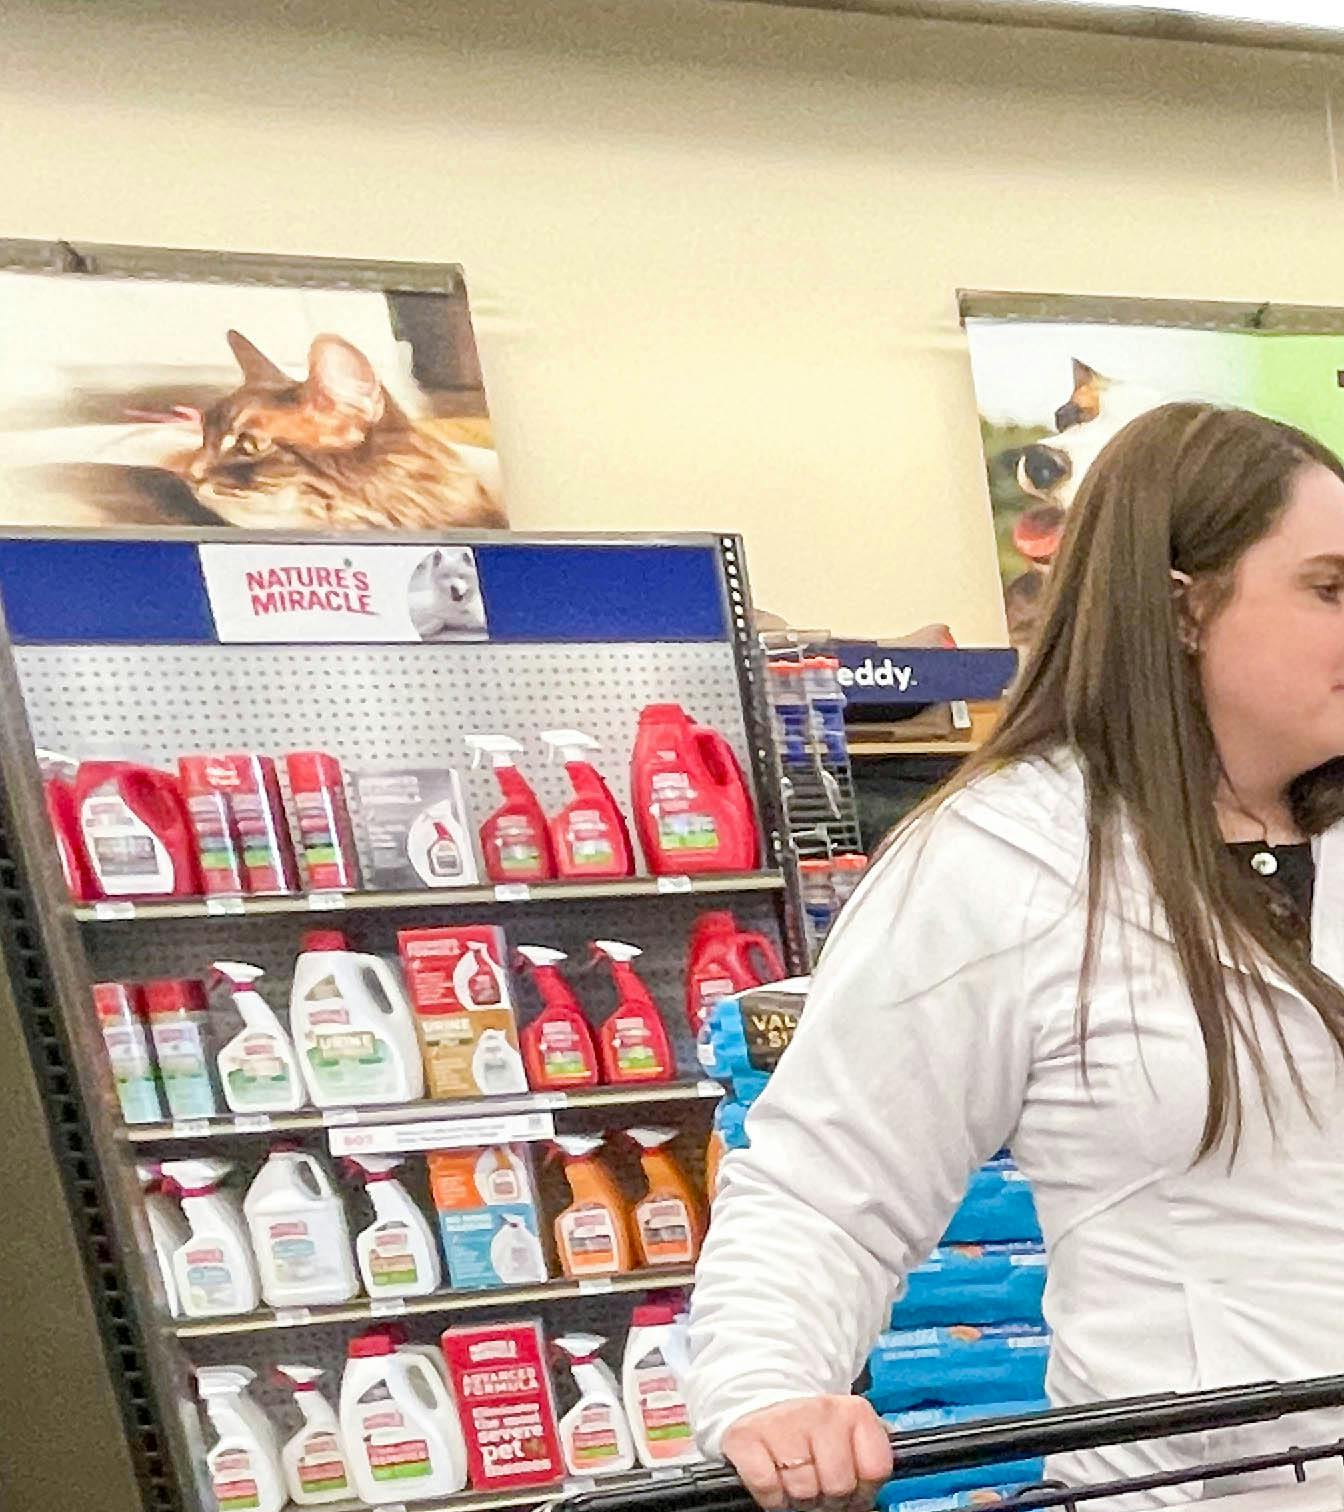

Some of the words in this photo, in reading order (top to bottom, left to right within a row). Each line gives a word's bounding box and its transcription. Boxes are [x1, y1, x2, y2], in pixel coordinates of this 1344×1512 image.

[246, 559, 370, 592] NATURE'S
[251, 590, 379, 616] MIRACLE
[837, 659, 918, 692] eddy.
[751, 1013, 798, 1030] VAL
